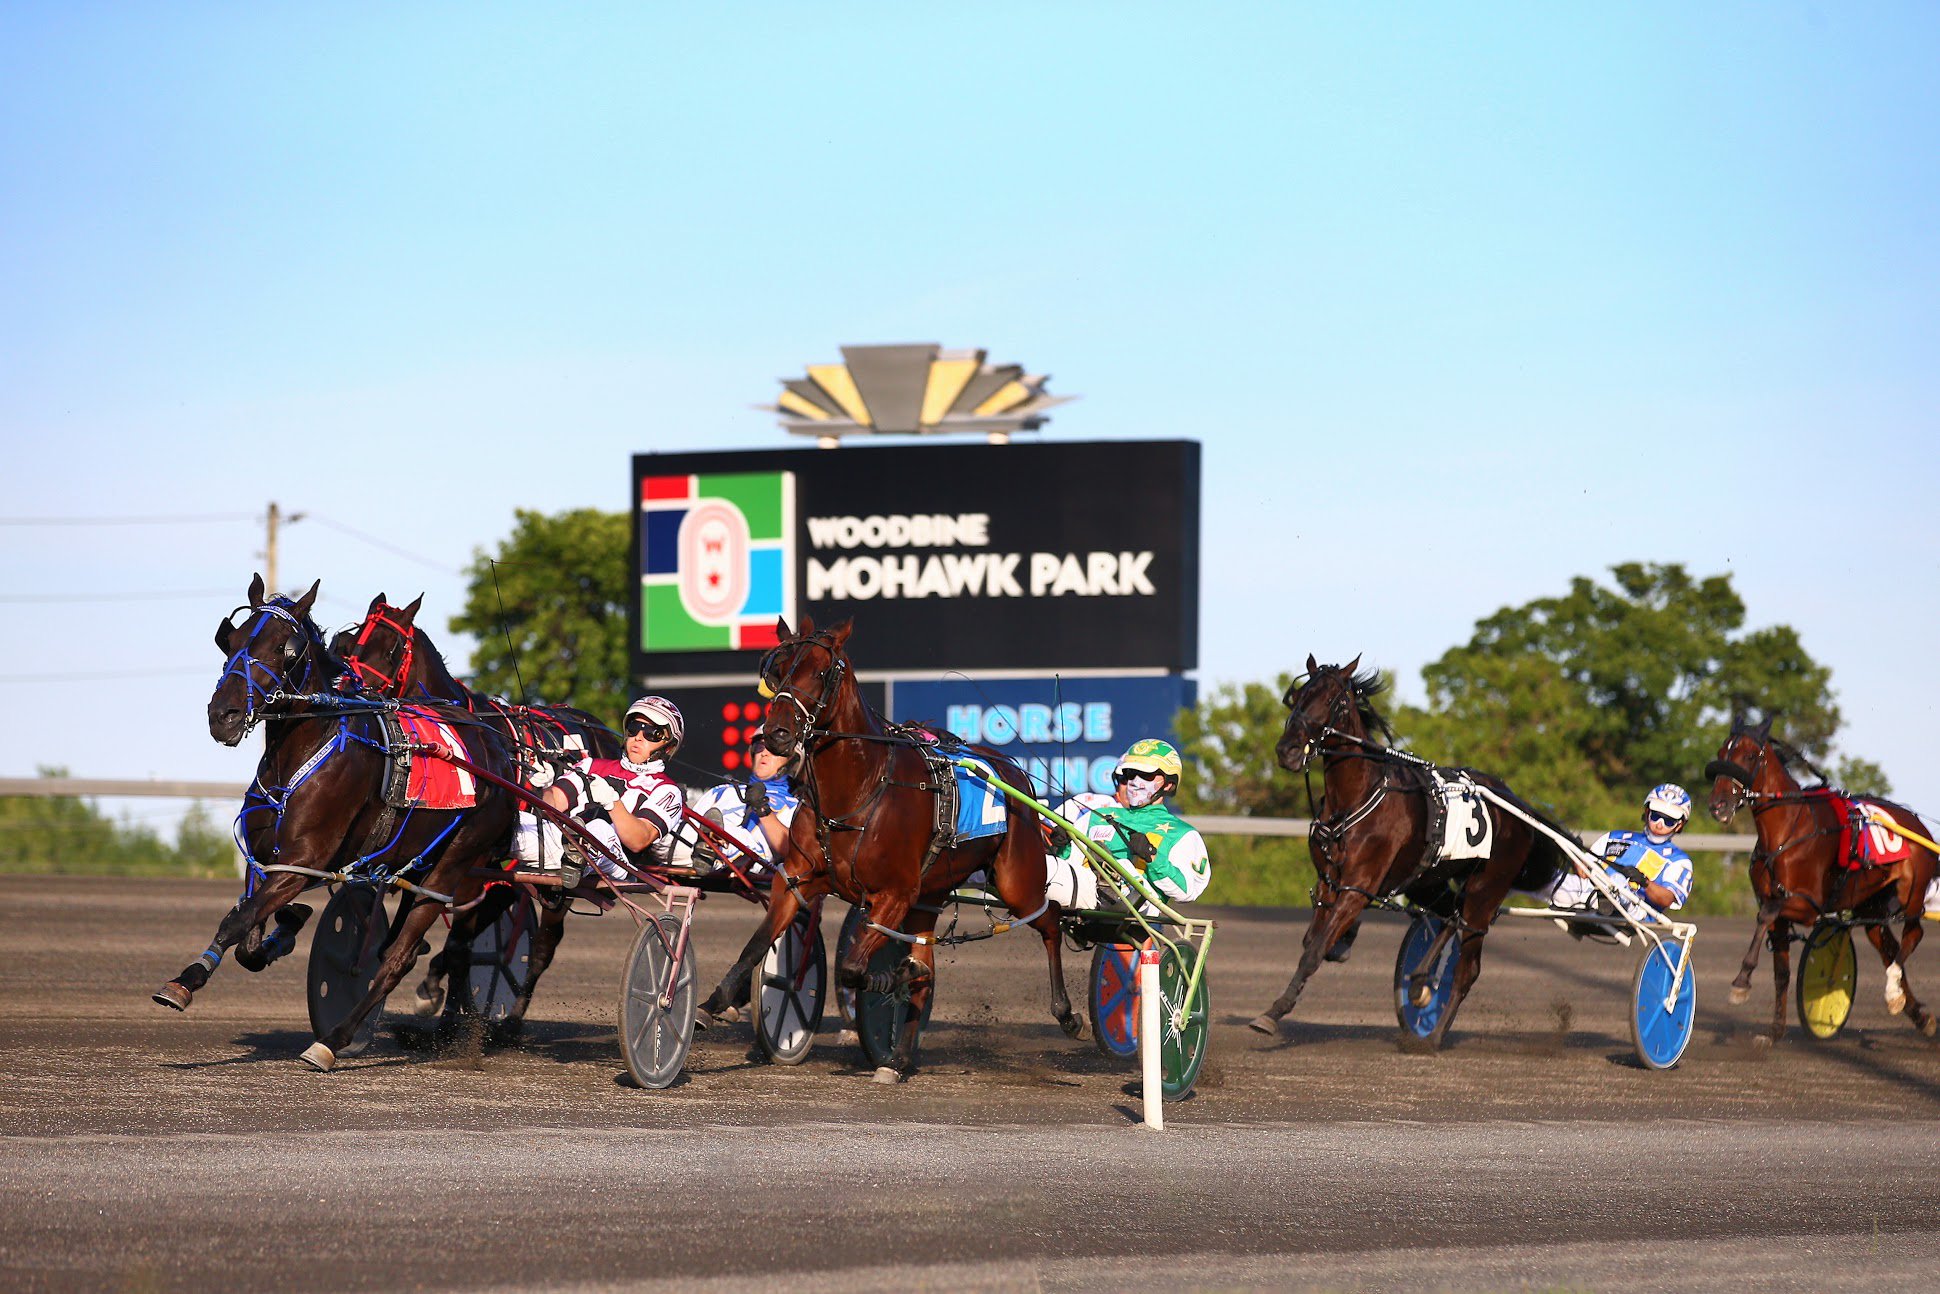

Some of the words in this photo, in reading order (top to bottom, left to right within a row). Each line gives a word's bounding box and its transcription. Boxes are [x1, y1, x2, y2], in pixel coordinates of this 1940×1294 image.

[807, 513, 989, 548] WOODBINE
[807, 554, 1024, 600] MOHAWK
[1030, 551, 1155, 597] PARK
[947, 702, 1112, 745] HORSE
[963, 757, 1007, 826] 2
[1462, 791, 1488, 847] 3
[1865, 804, 1903, 855] 10
